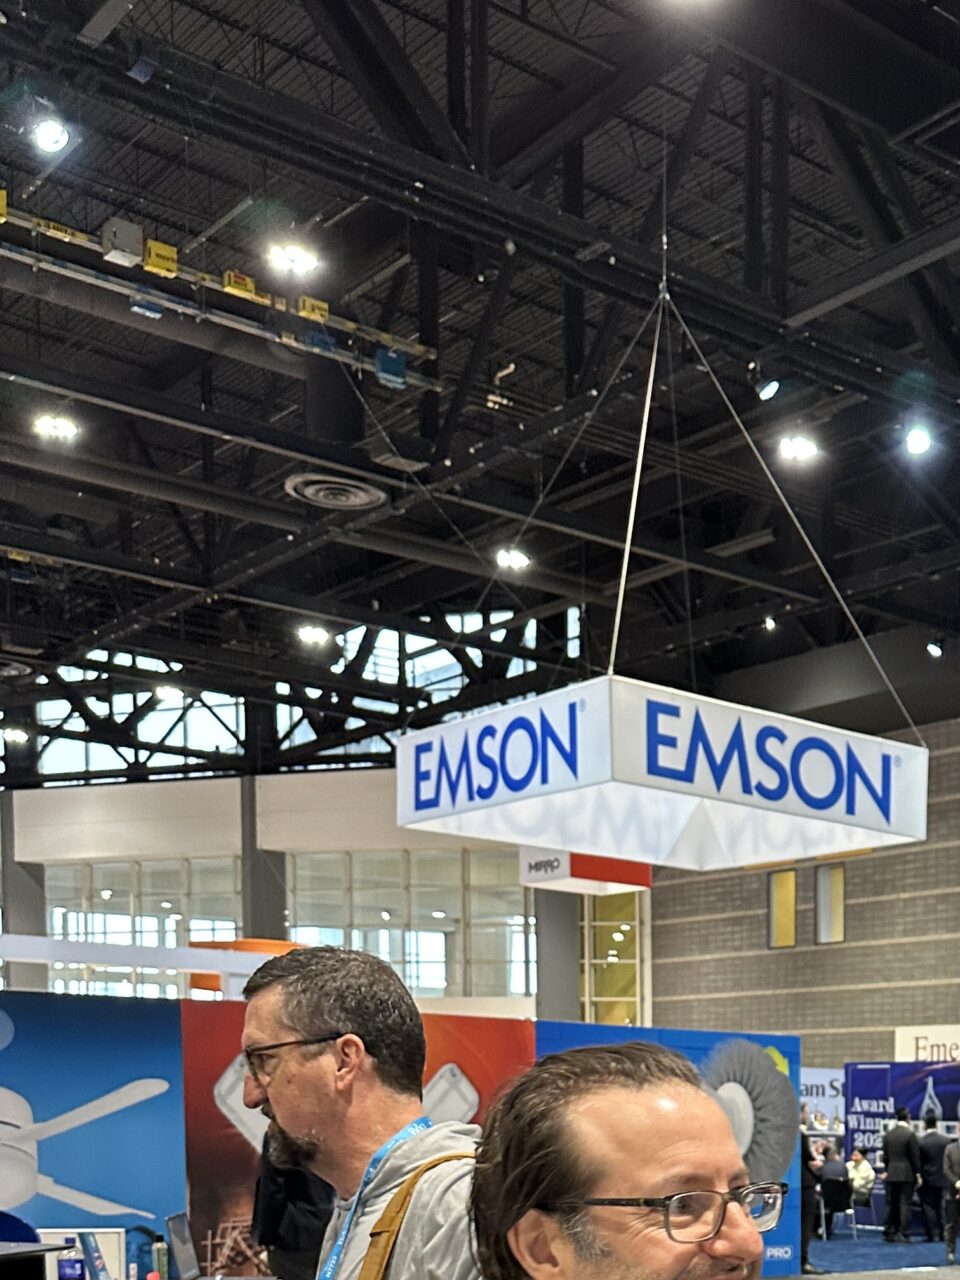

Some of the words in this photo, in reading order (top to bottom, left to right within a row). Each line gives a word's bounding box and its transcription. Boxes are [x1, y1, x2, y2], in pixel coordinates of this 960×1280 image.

[414, 701, 579, 811] EMSON
[646, 698, 891, 825] EMSON
[851, 1097, 895, 1113] Award
[766, 1247, 792, 1258] PRO
